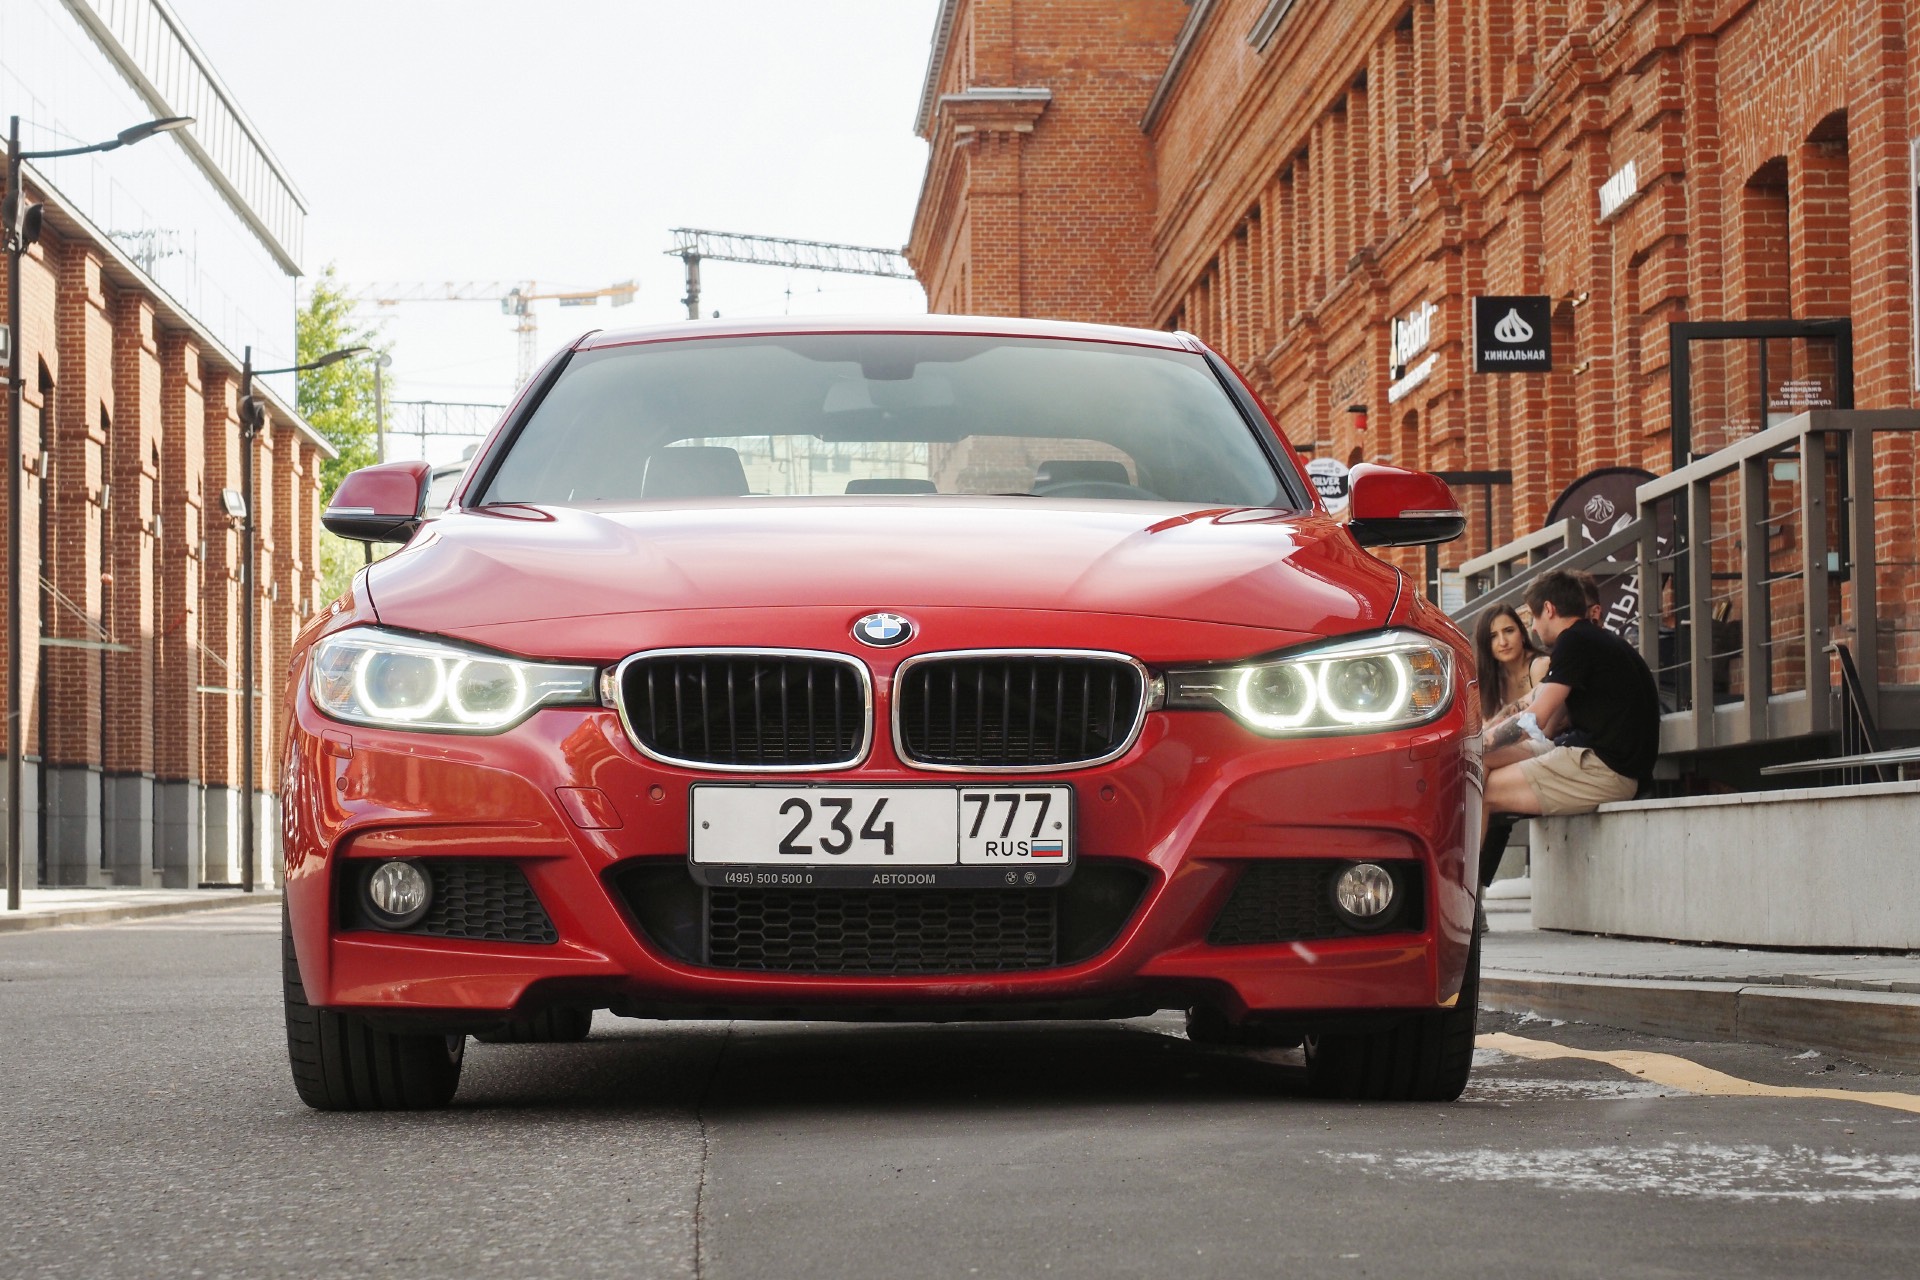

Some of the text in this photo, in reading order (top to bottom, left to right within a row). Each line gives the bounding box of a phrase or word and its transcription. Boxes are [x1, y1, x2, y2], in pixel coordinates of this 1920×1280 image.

[1484, 350, 1546, 361] ХИНКАЛЬНАЯ
[1312, 477, 1340, 486] SILVER
[1317, 486, 1341, 495] ANDA
[963, 793, 1052, 839] 777
[778, 797, 895, 856] 234
[986, 841, 1029, 857] RUS
[725, 872, 813, 884] (495) 500 500 0
